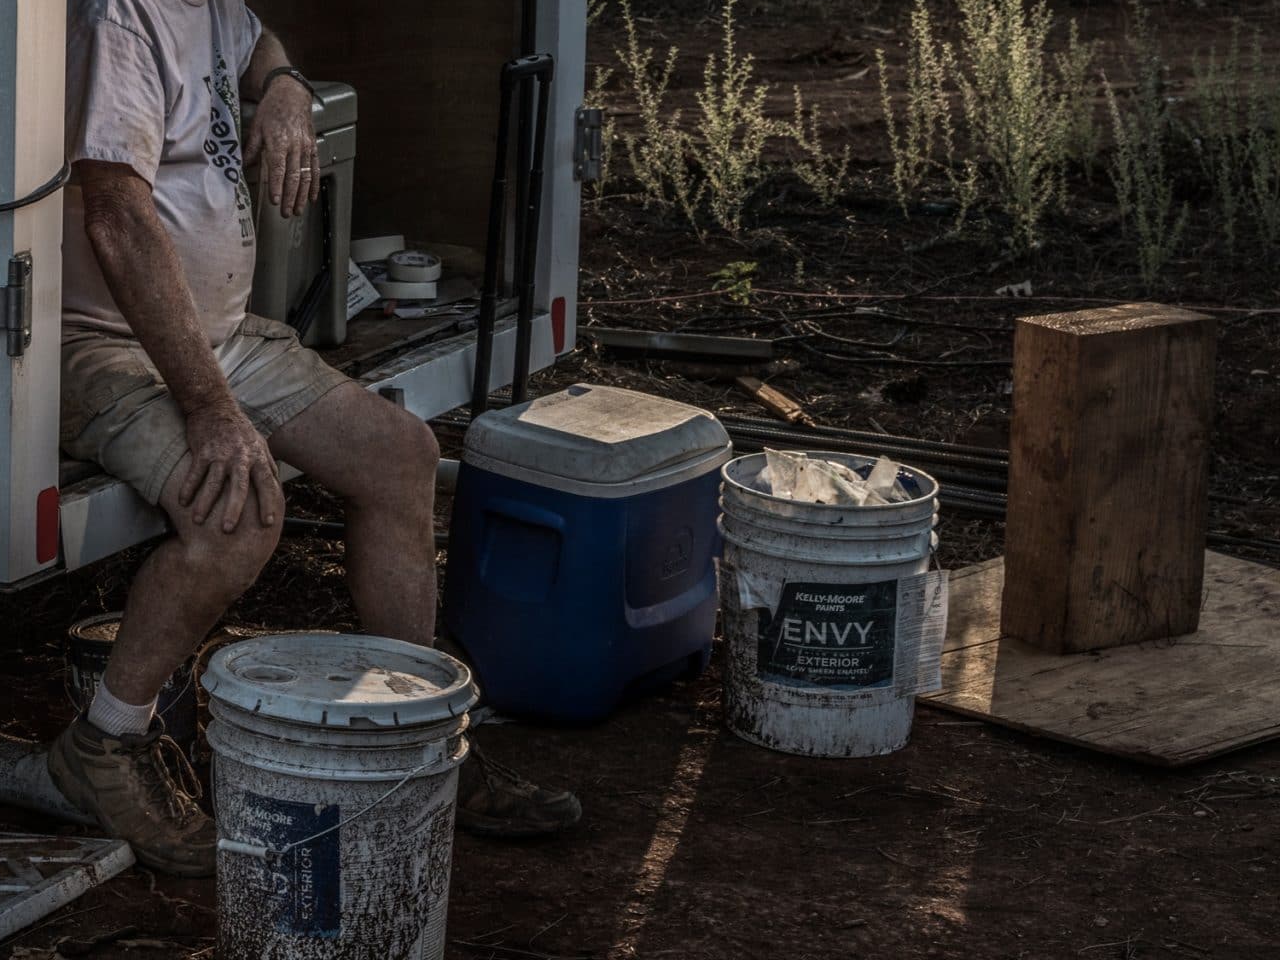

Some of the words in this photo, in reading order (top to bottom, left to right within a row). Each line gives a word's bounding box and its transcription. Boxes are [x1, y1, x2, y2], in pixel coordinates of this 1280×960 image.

[796, 591, 865, 604] KELLY-MOORE
[815, 604, 846, 612] PAINTS
[783, 618, 874, 645] ENVY
[797, 655, 860, 668] EXTERIOR
[301, 847, 313, 920] EXTERIOR
